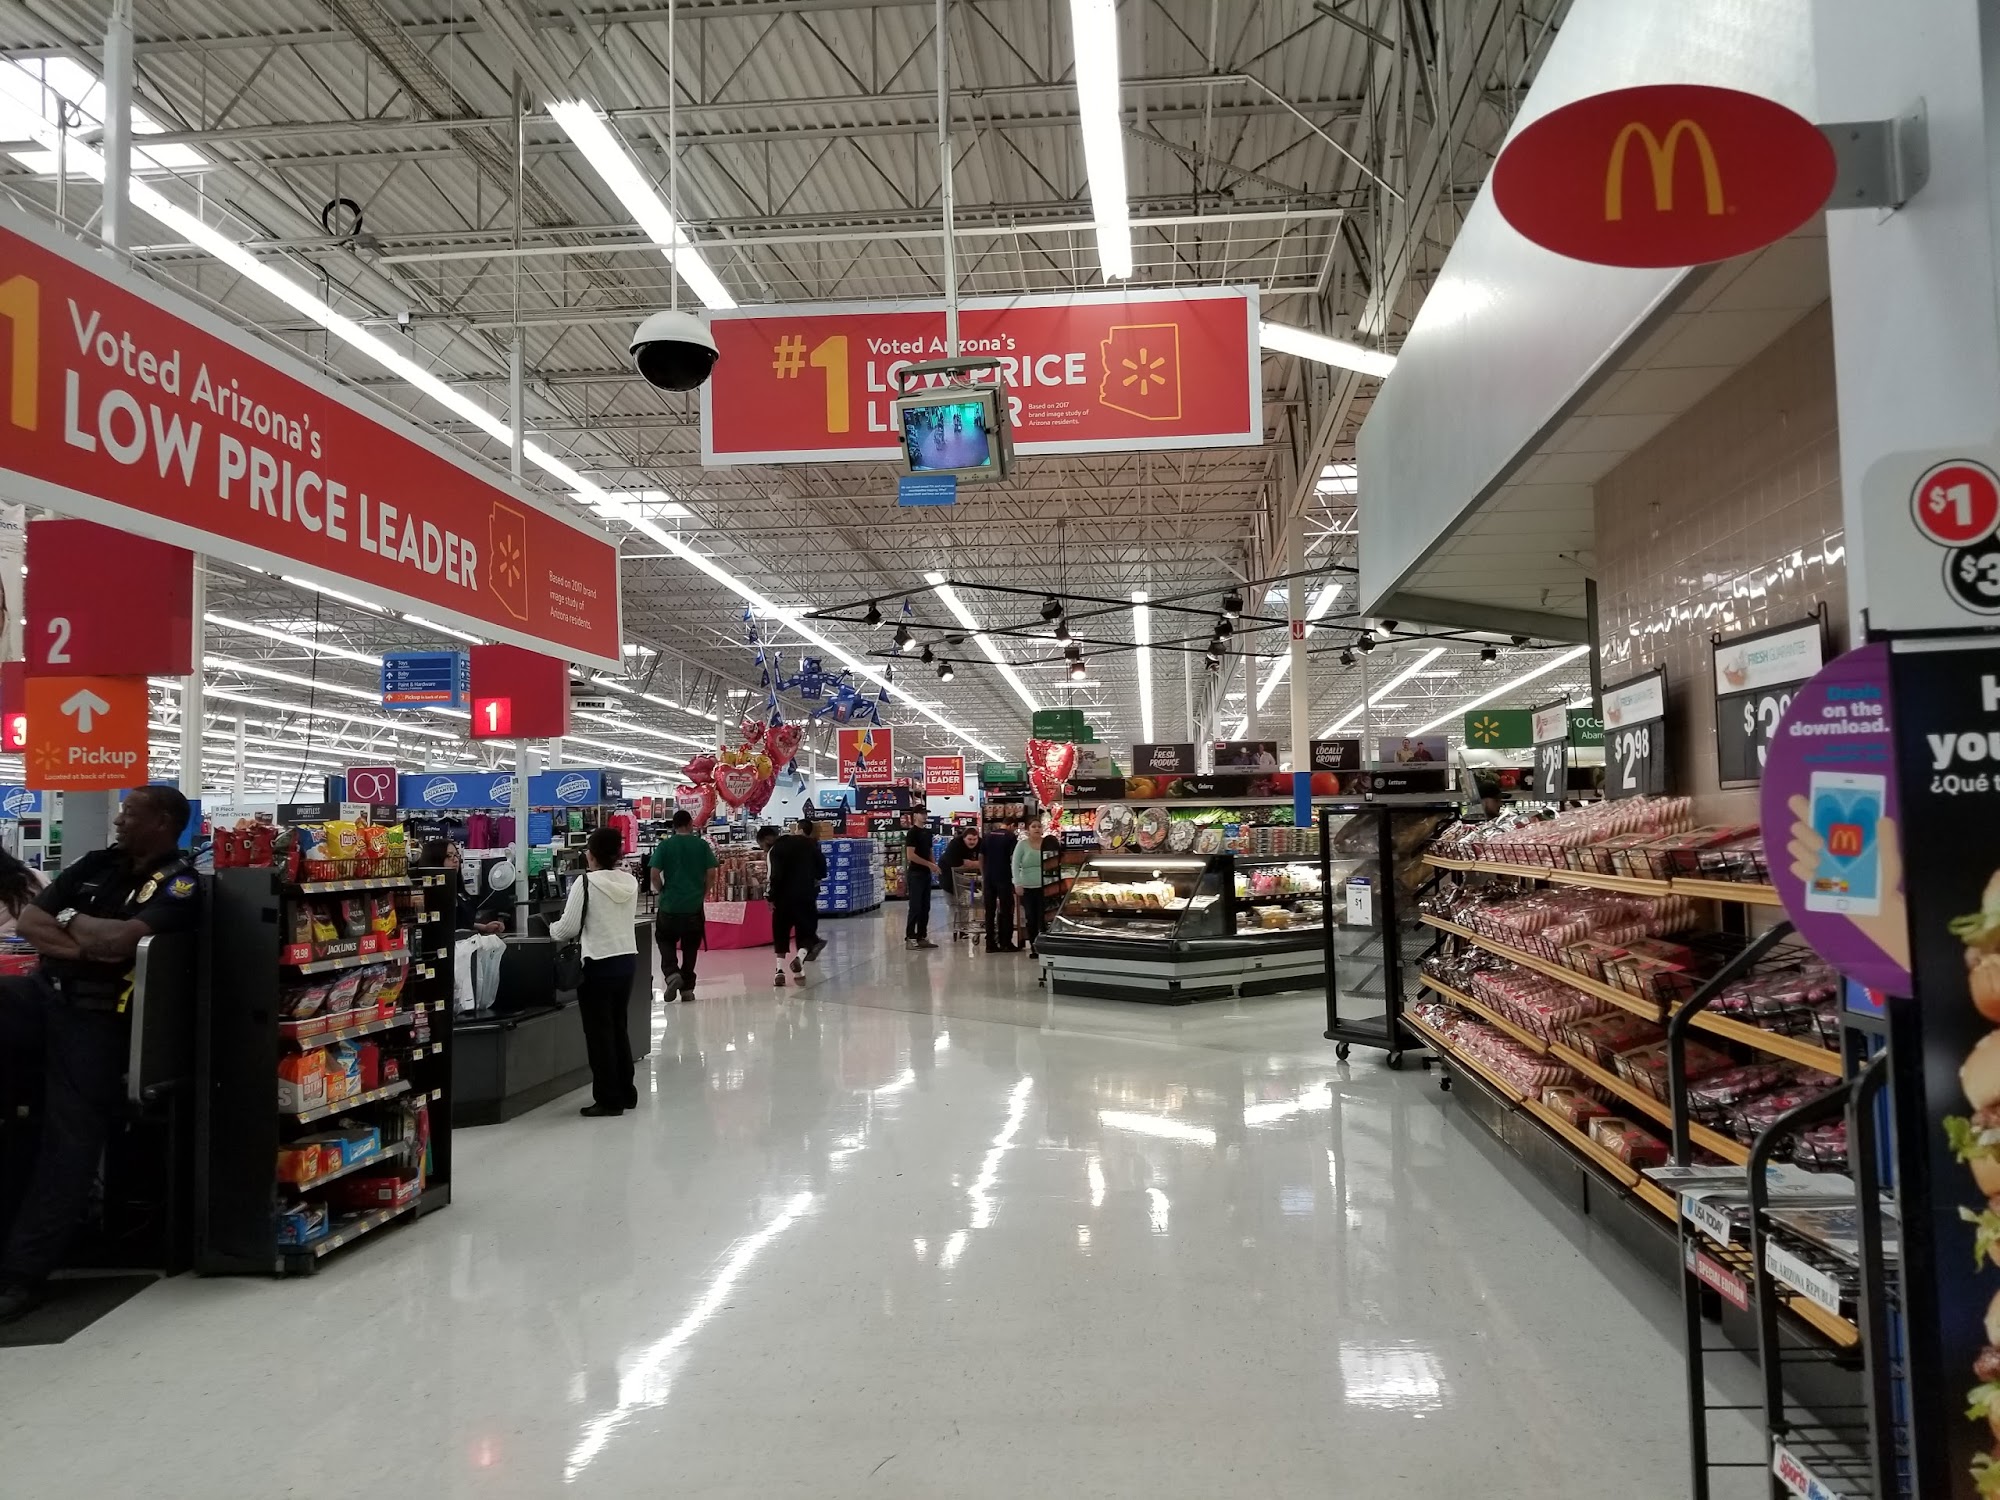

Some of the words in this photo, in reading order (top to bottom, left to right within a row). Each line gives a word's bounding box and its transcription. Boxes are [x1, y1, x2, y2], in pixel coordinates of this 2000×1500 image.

[867, 337, 923, 354] Voted
[68, 298, 180, 396] Voted
[191, 364, 321, 459] Arizona's
[772, 334, 850, 434] #1
[1028, 402, 1046, 410] Based
[1028, 410, 1045, 418] brand
[1046, 410, 1064, 419] image
[1065, 410, 1082, 418] study
[1051, 418, 1080, 426] residents.
[65, 369, 202, 487] LOW
[219, 437, 346, 542] PRICE
[360, 493, 478, 591] LEADER
[1929, 483, 1972, 526] $1
[548, 570, 564, 586] Based
[565, 580, 571, 588] on
[572, 580, 582, 593] 2017
[583, 584, 596, 598] brand
[550, 590, 564, 605] image
[565, 596, 578, 611] study
[579, 600, 584, 610] of
[550, 606, 568, 622] Arizona
[569, 616, 592, 630] residents.
[47, 617, 71, 664] 2
[1748, 652, 1768, 665] FRESH
[486, 702, 498, 732] 1
[1822, 706, 1847, 718] on
[1852, 702, 1883, 717] the
[13, 716, 27, 746] 3
[1790, 718, 1890, 736] download.
[68, 746, 137, 768] Pickup
[1153, 750, 1176, 759] FRESH
[1316, 747, 1344, 755] LOCALLY
[1316, 755, 1341, 763] GROWN
[1150, 758, 1180, 767] PRODUCE
[44, 772, 71, 780] Located
[1930, 774, 1989, 795] ¿Qué
[1066, 836, 1081, 844] Low
[1081, 836, 1098, 844] Price
[1355, 898, 1362, 910] $1
[293, 948, 309, 959] $3.98
[327, 943, 341, 955] JACK
[363, 939, 376, 950] $3.98
[1694, 1204, 1705, 1223] USA
[1705, 1213, 1723, 1235] TODAY
[1699, 1260, 1721, 1287] SPECIAL
[1721, 1276, 1745, 1304] EDITION
[1767, 1254, 1777, 1272] THE
[1779, 1264, 1804, 1290] ARIZONA
[1805, 1277, 1836, 1310] REPUBLIC
[1780, 1454, 1808, 1493] Sports
